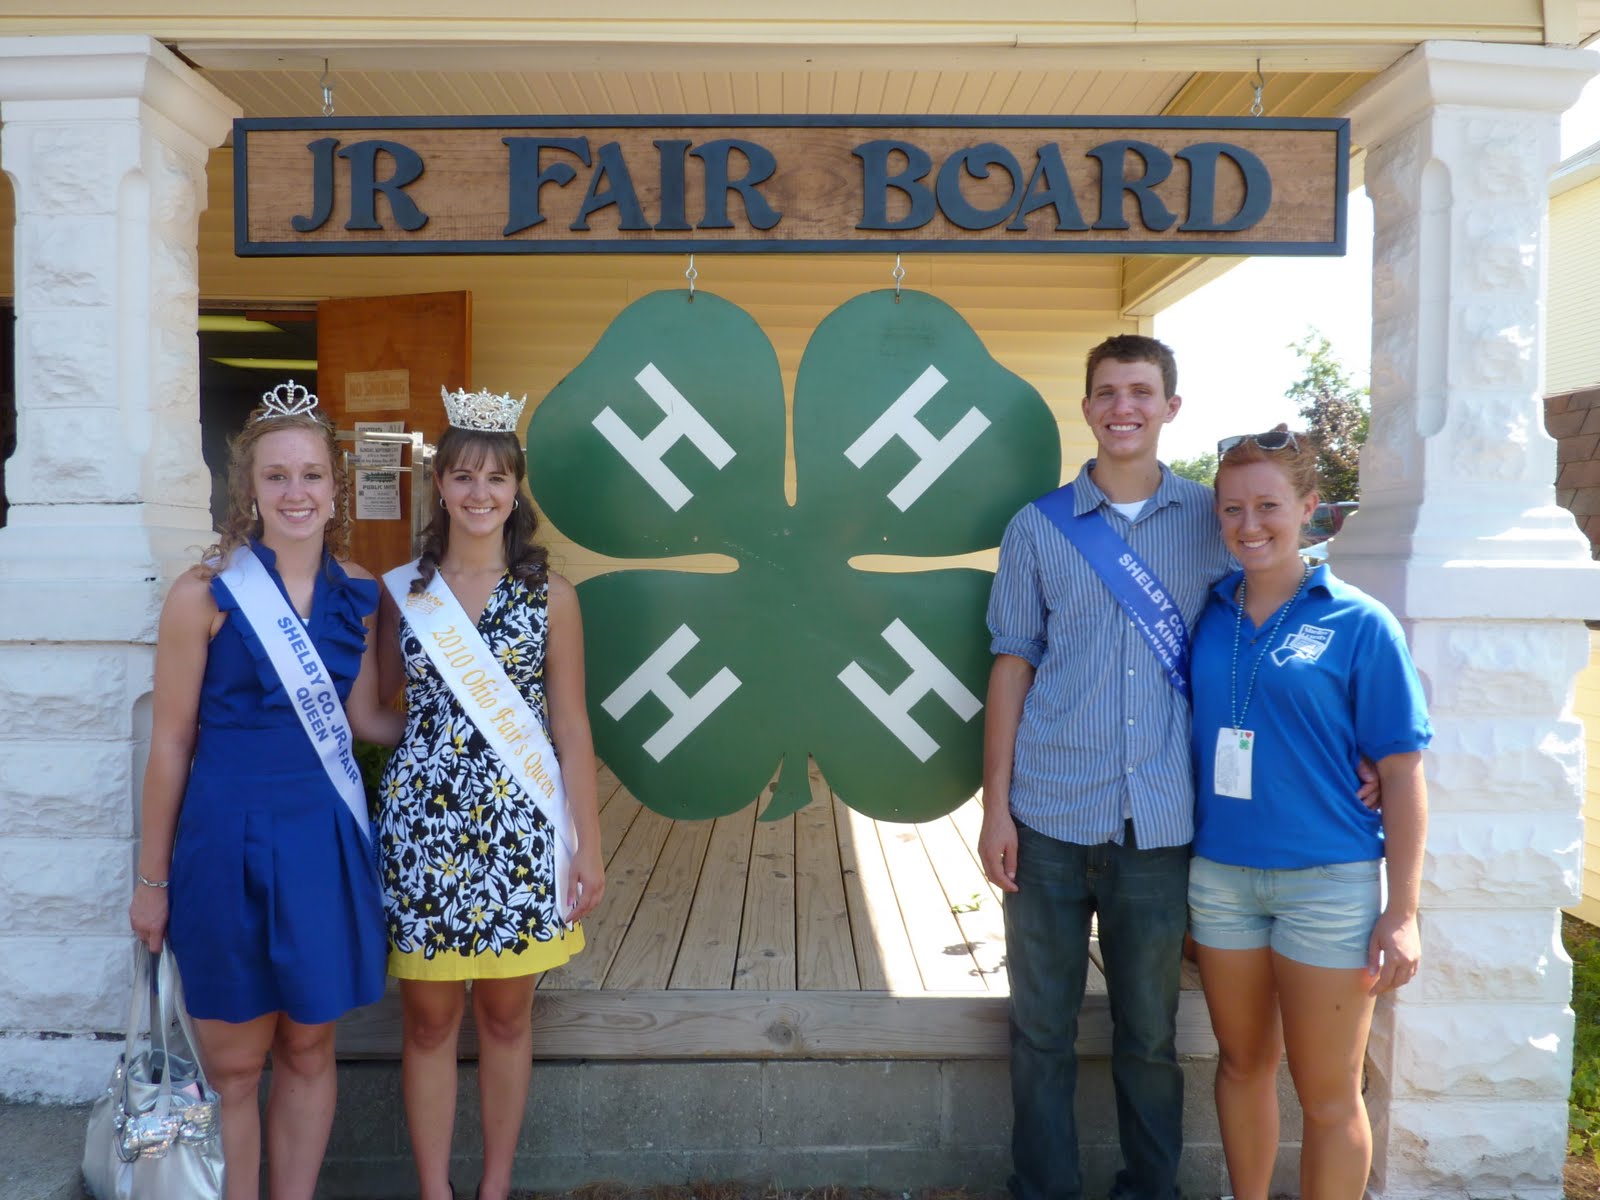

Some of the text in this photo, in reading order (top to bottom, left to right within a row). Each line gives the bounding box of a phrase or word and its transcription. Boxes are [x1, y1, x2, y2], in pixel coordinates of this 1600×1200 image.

[292, 135, 1273, 236] JR FAIR BOARD
[591, 362, 737, 513] H
[843, 364, 992, 513] H
[1118, 552, 1186, 642] SHELBY CO.
[1154, 619, 1182, 657] KING
[277, 616, 359, 785] SHELBY CO. JR. FAIR
[296, 687, 330, 743] QUEEN
[432, 625, 557, 800] 2010 Ohio Fair's Queen
[600, 623, 743, 764] H
[836, 617, 985, 764] H
